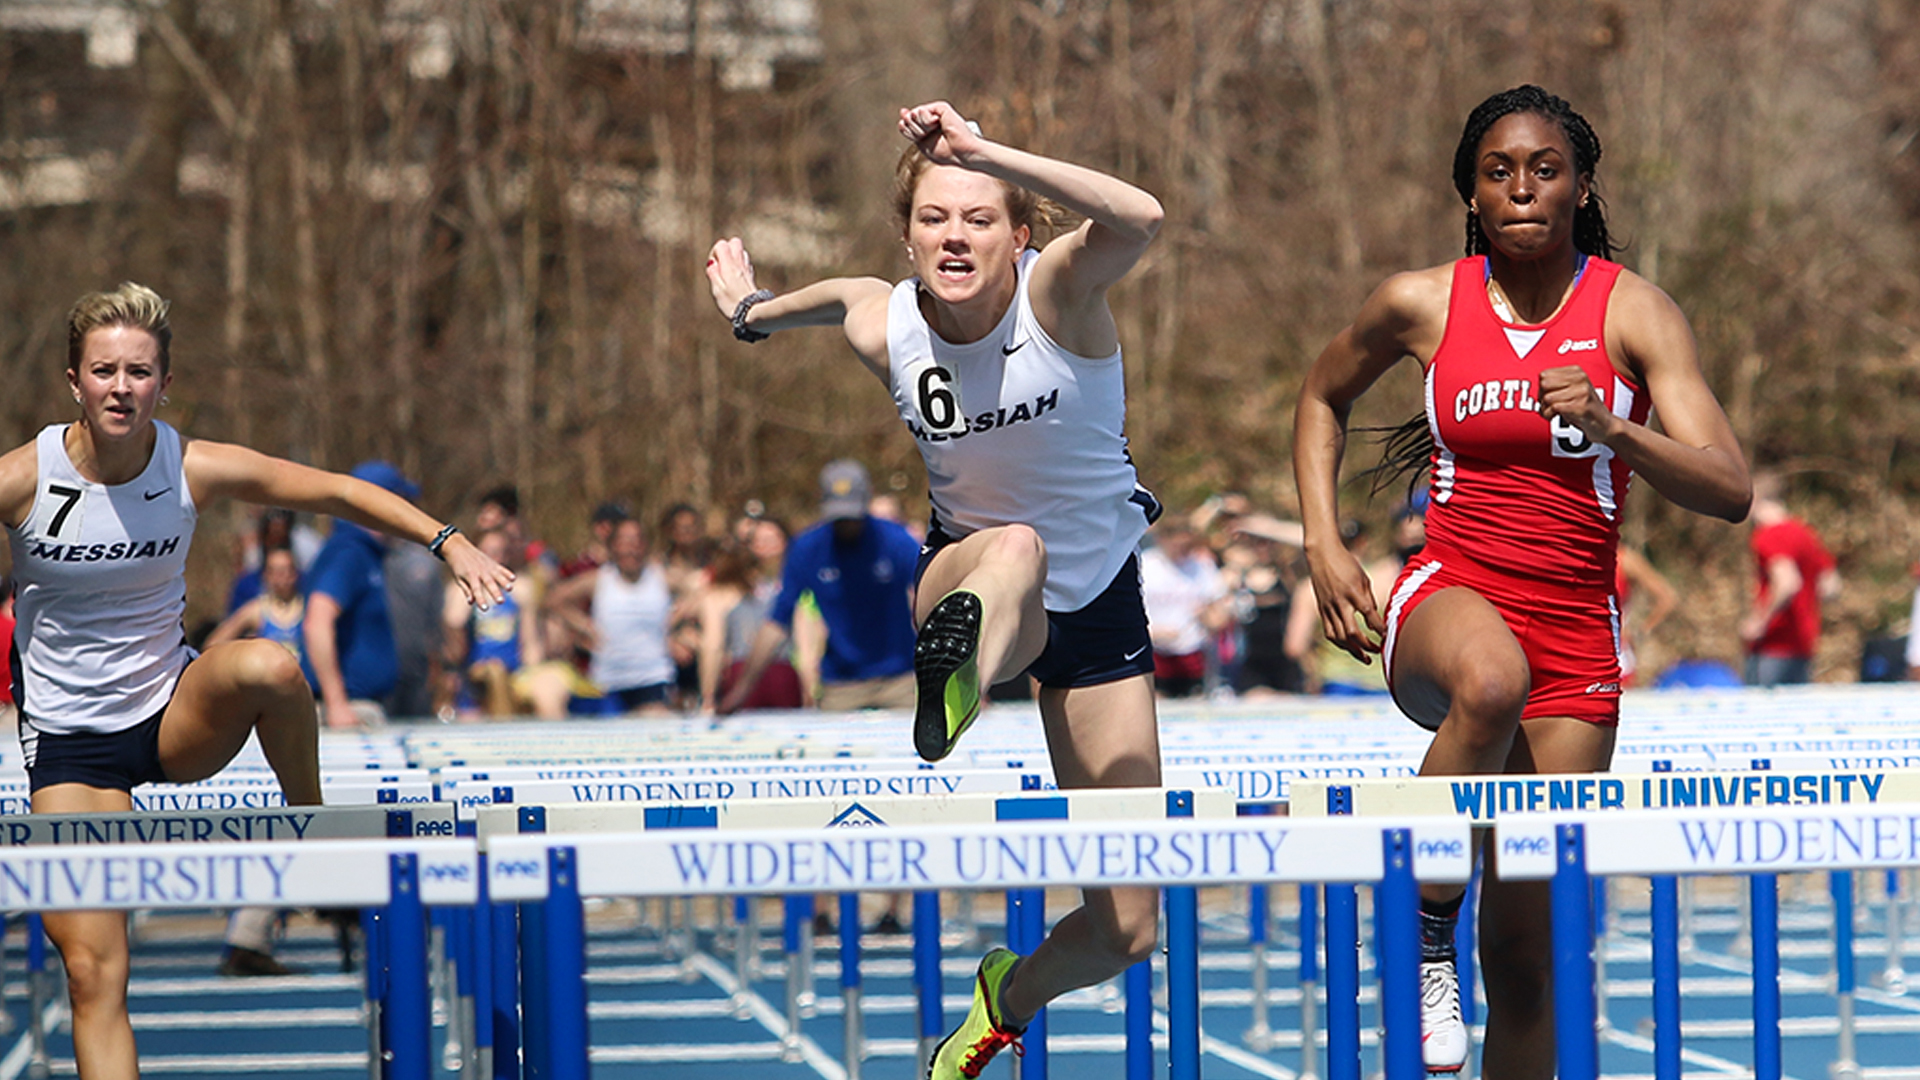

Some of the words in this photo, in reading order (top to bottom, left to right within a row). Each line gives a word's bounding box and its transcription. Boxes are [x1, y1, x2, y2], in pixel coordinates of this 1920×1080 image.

[917, 366, 956, 430] 6
[1455, 379, 1600, 422] CORTL
[46, 484, 82, 538] 7
[30, 535, 180, 562] MESSIAH
[1451, 779, 1624, 819] WIDENER
[1642, 773, 1885, 808] UNIVERSITY
[50, 813, 315, 845] UNIVERSITY
[670, 838, 931, 888] WIDENER
[952, 829, 1289, 882] UNIVERSITY
